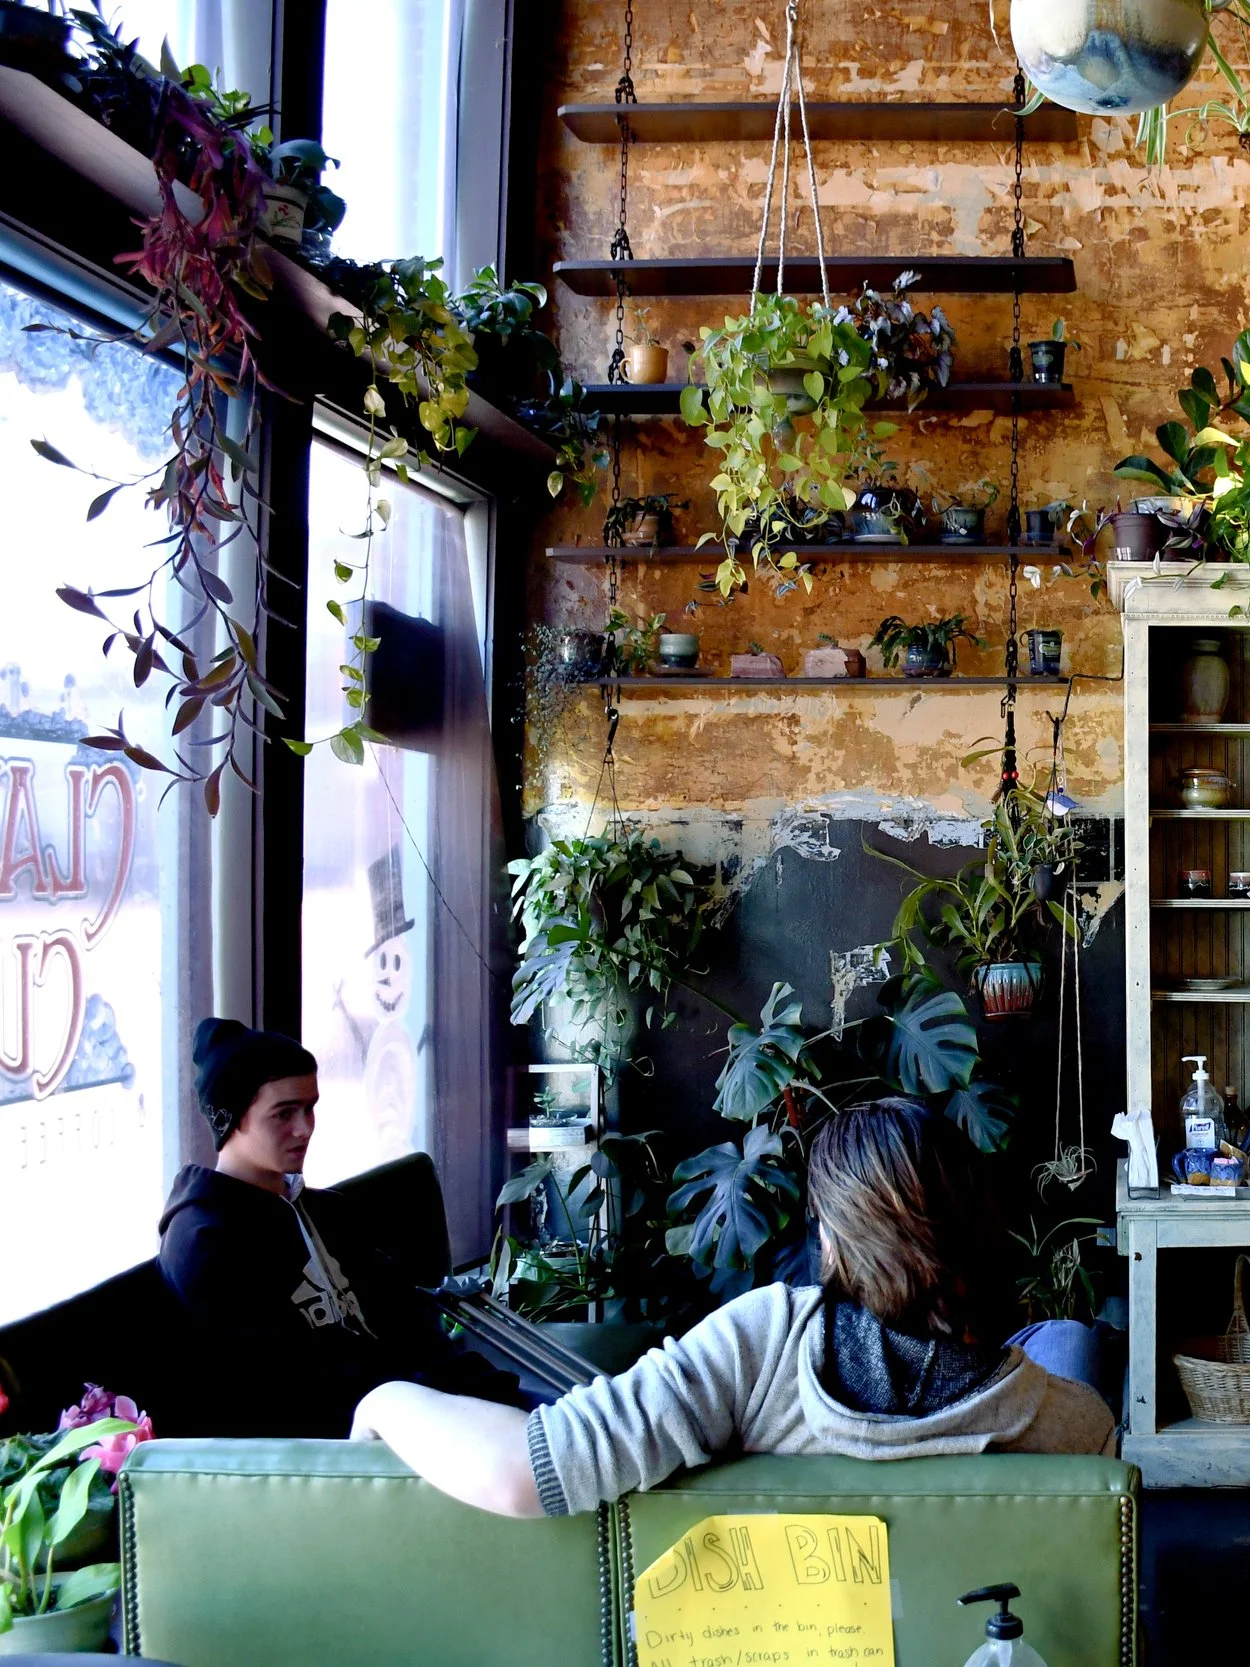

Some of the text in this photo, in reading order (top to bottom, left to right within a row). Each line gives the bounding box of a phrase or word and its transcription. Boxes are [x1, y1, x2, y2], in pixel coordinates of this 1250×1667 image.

[648, 1525, 882, 1599] DISH BIN
[645, 1629, 694, 1649] Dirty
[702, 1625, 740, 1639] dishes
[752, 1623, 763, 1633] in
[772, 1621, 789, 1633] the
[806, 1646, 819, 1657] in
[828, 1645, 859, 1657] trash
[863, 1646, 884, 1657] can
